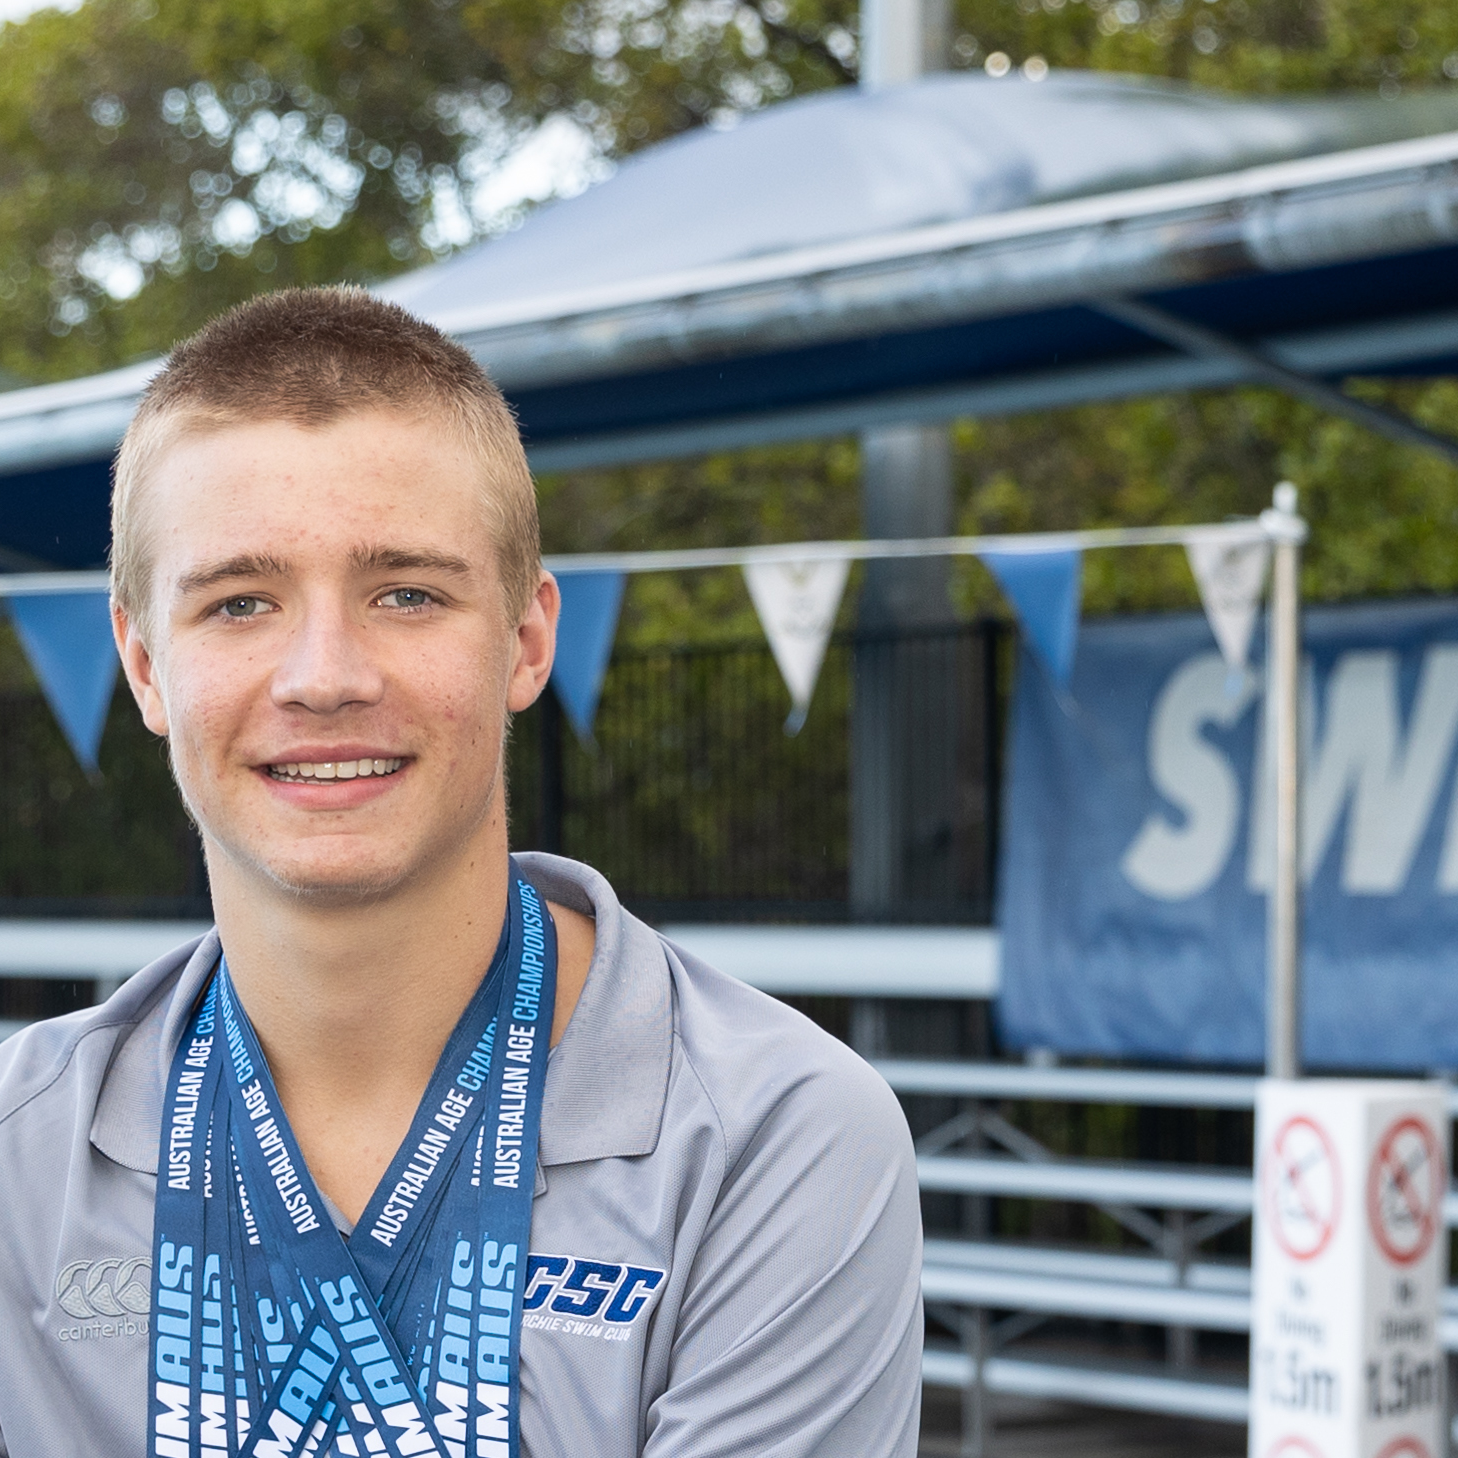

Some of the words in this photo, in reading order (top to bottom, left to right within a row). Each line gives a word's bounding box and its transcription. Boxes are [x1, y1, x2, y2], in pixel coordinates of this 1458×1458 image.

[513, 879, 544, 1022] CHAMPIONSHIPS
[185, 1036, 214, 1068] AGE
[506, 1024, 535, 1065] AGE
[168, 1071, 204, 1190] AUSTRALIAN
[241, 1079, 271, 1121] AGE
[493, 1067, 530, 1189] AUSTRALIAN
[254, 1118, 320, 1234] AUSTRALIAN
[370, 1128, 451, 1248] AUSTRALIAN
[441, 1088, 473, 1132] AGE
[58, 1317, 150, 1341] canterbu
[563, 1319, 603, 1338] SWIM
